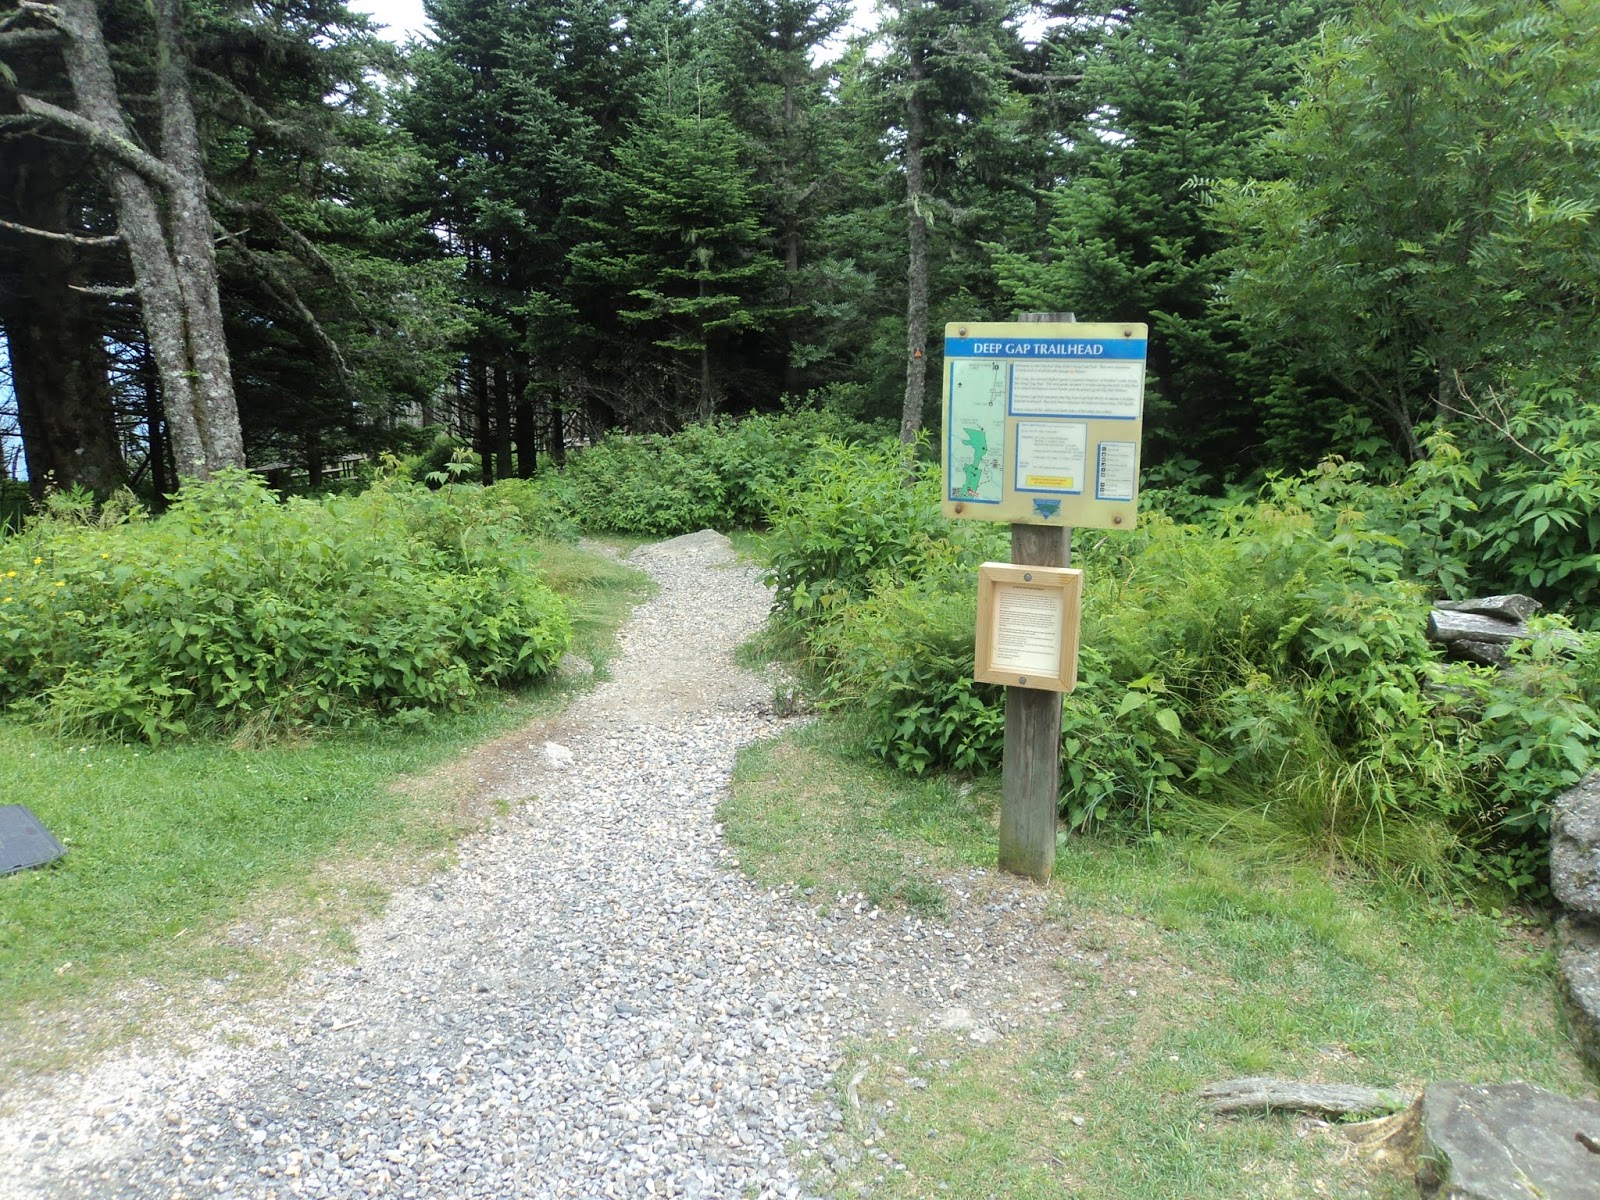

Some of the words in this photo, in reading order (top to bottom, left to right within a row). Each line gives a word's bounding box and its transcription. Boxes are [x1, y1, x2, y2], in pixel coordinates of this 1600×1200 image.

[973, 343, 1002, 354] DEEP
[1005, 343, 1031, 354] GAP
[1033, 343, 1104, 355] TRAILHEAD
